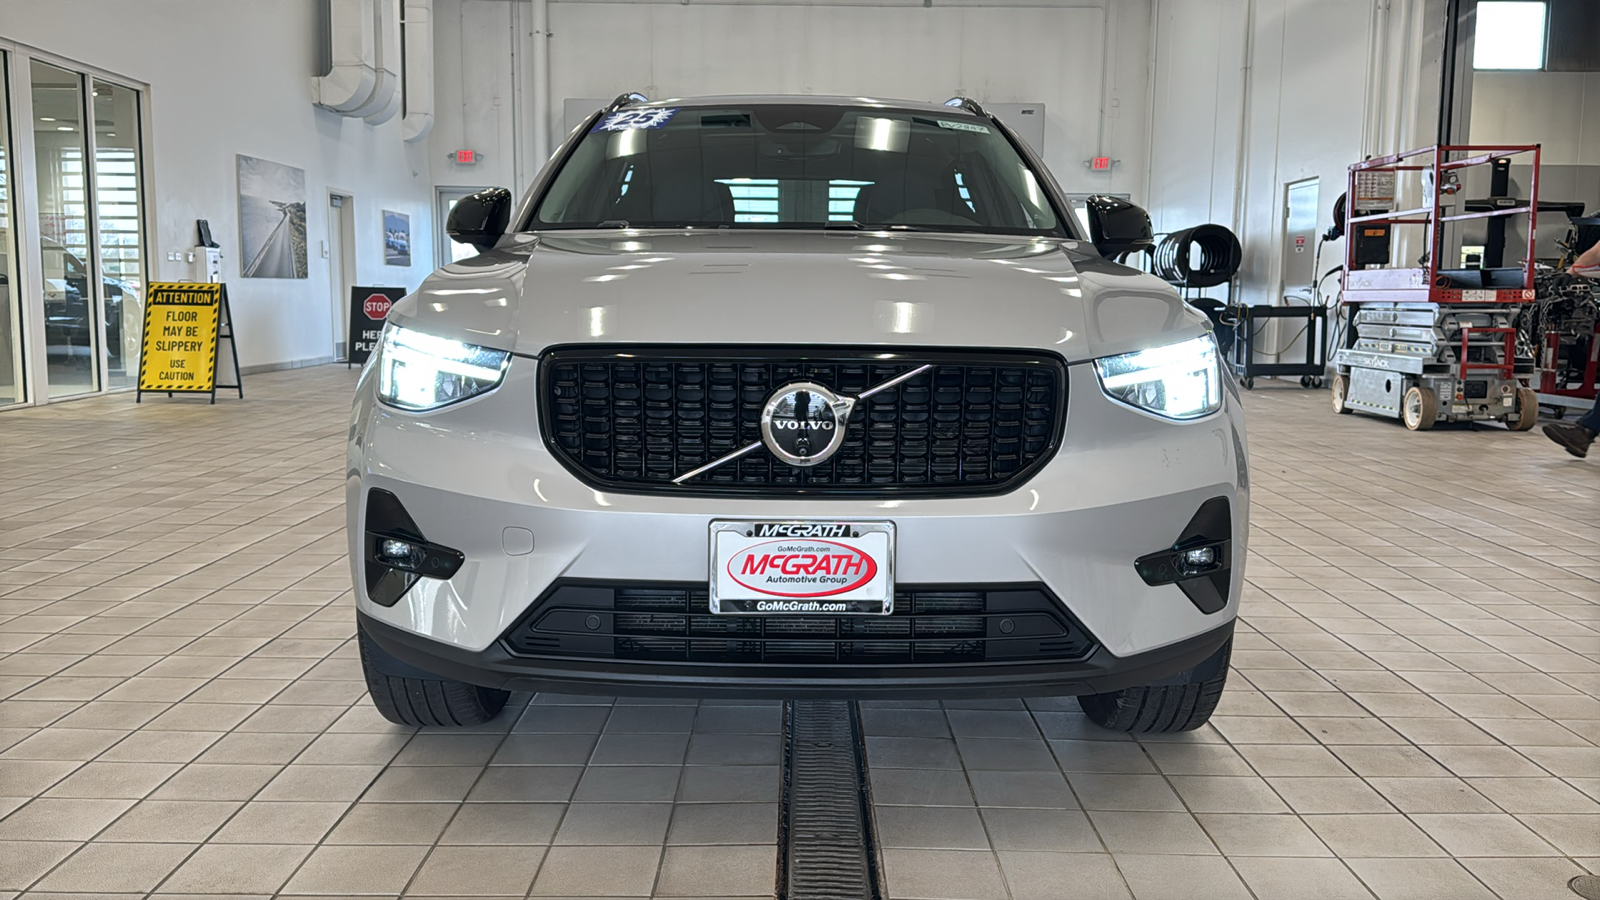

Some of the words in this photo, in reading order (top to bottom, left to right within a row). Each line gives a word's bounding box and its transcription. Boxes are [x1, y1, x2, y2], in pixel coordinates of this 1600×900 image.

[613, 112, 659, 125] 25
[458, 150, 473, 162] EXIT
[1094, 157, 1109, 169] EXIT
[155, 292, 211, 304] ATTENTION
[365, 302, 390, 312] STOP
[166, 311, 198, 322] FLOOR
[162, 326, 184, 337] MAY
[186, 326, 199, 337] BE
[155, 341, 203, 352] SLIPPERY
[169, 359, 186, 369] USE
[159, 371, 194, 381] CAUTION
[773, 420, 834, 430] VOLVO
[759, 524, 845, 537] McGRATH
[777, 545, 831, 553] GoMcGrath.com
[741, 554, 866, 575] McGRATH
[766, 575, 817, 584] Automotive
[819, 576, 848, 585] Group
[757, 601, 846, 612] GoMcGrath.com
